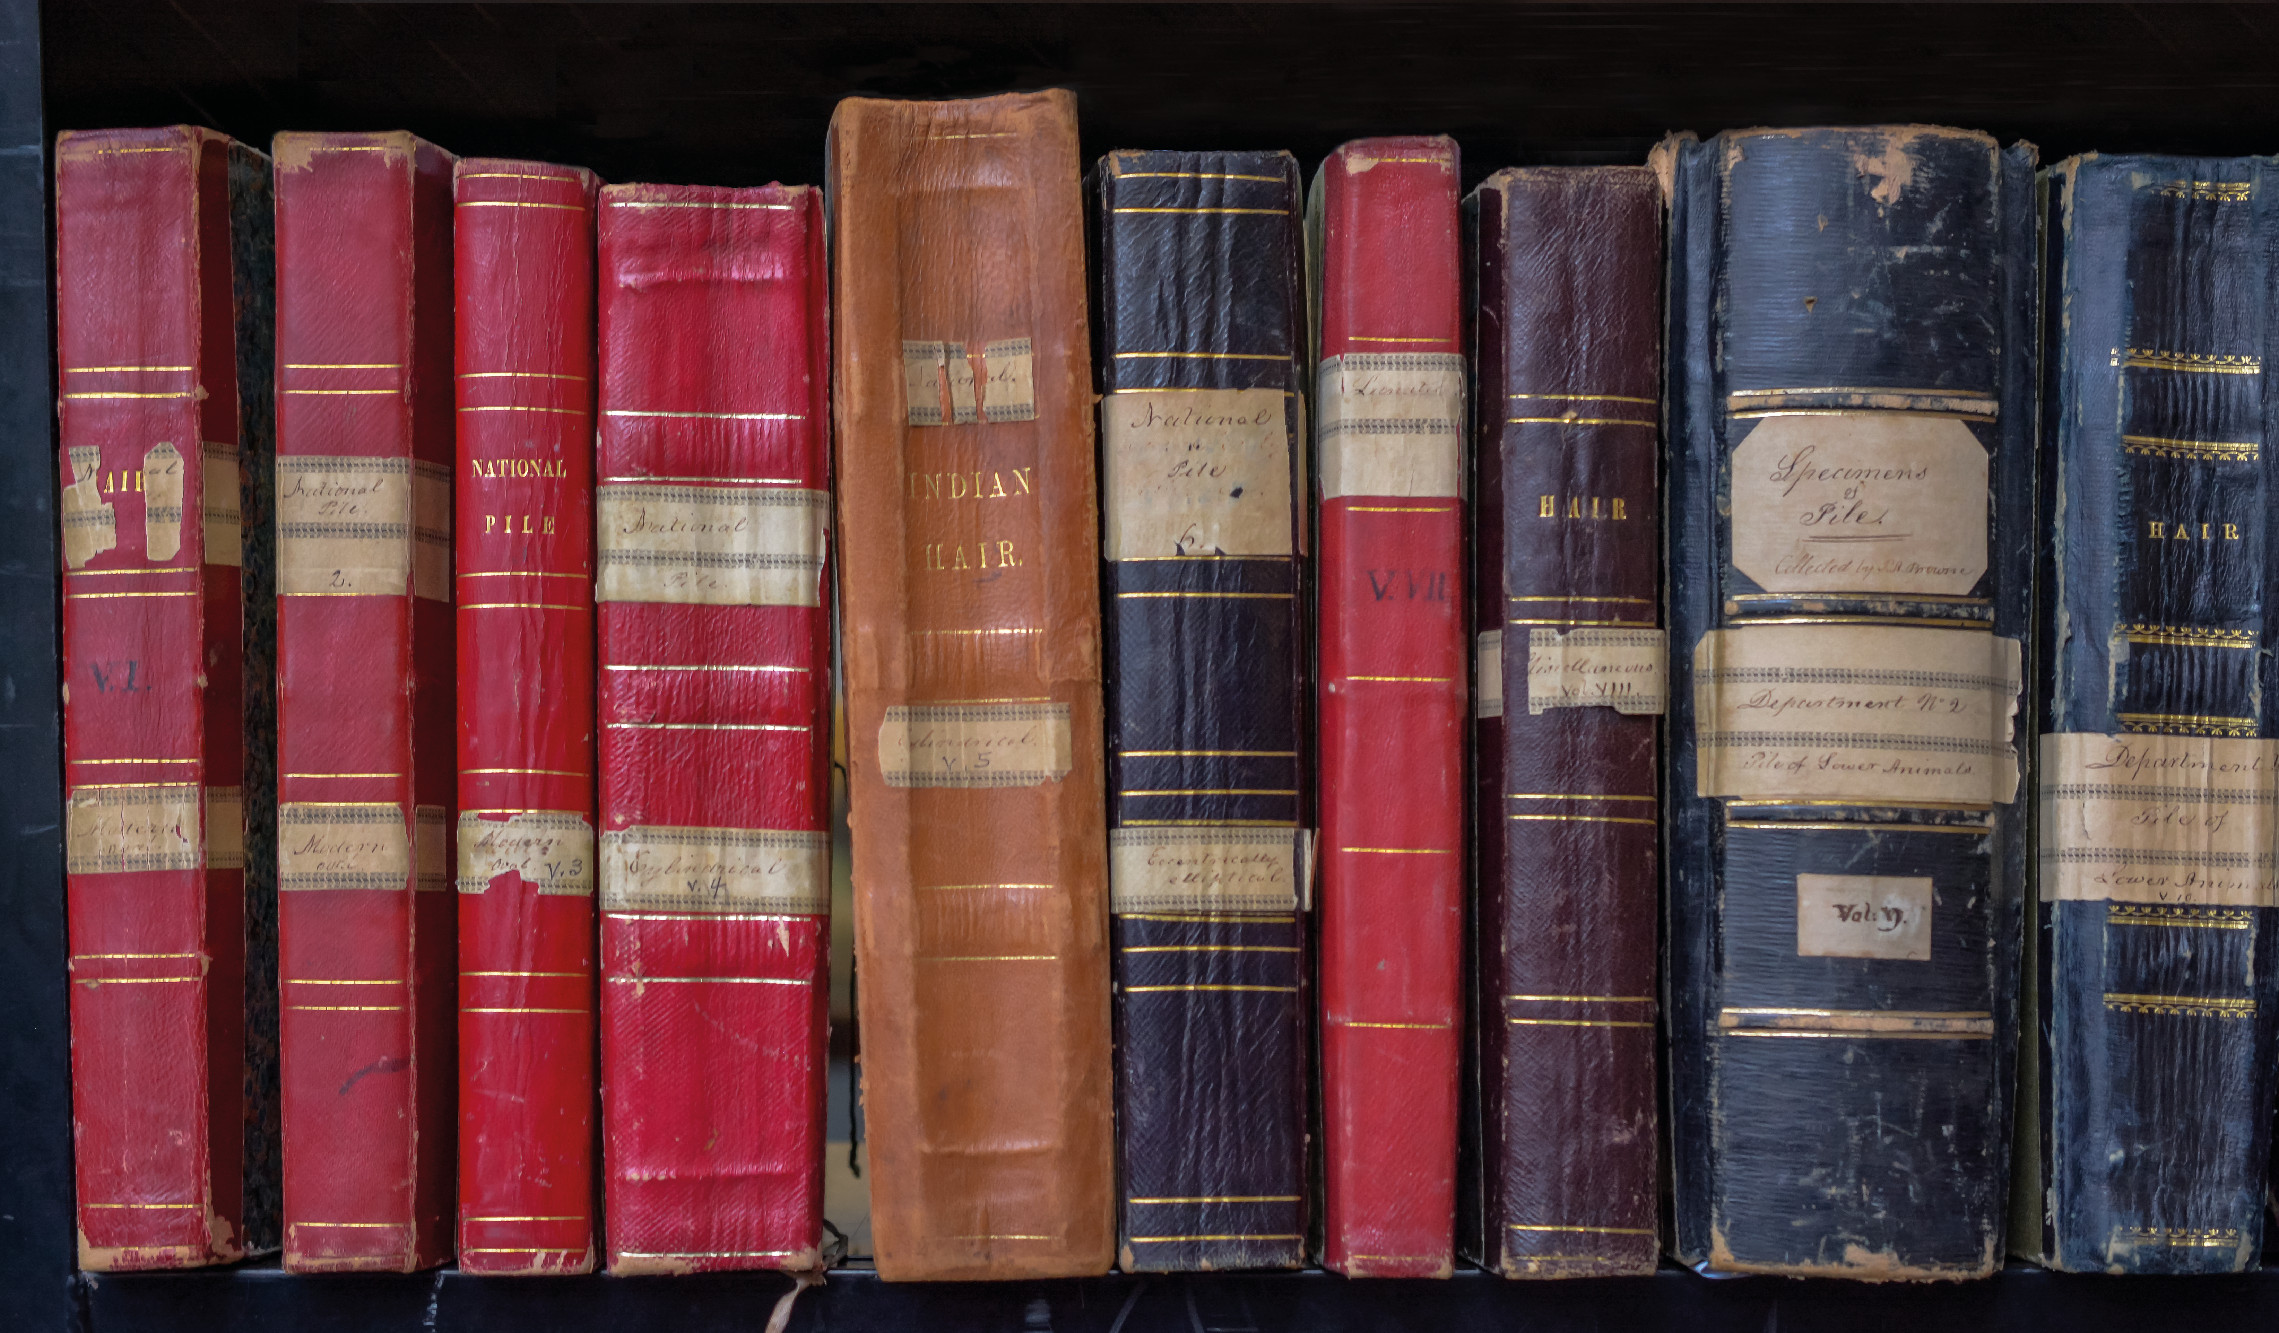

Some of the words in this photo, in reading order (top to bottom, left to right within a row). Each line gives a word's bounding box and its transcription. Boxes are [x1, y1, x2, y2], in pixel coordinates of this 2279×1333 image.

[1131, 402, 1272, 429] National
[471, 458, 567, 478] NATIONAL
[1769, 445, 1928, 497] Specimens
[283, 475, 384, 498] National
[909, 467, 1031, 499] INDIAN
[1844, 486, 1859, 500] of
[1540, 495, 1627, 520] HAIR
[485, 514, 555, 535] PILE
[623, 507, 749, 535] National
[2148, 521, 2240, 541] HAIR
[1775, 553, 1849, 576] Collected
[1737, 688, 1903, 717] Department
[1744, 751, 1784, 770] Pile
[1786, 756, 1809, 774] of
[1882, 758, 1973, 775] Animals
[2085, 745, 2260, 781] Department
[2131, 804, 2196, 825] Pile
[2204, 810, 2229, 833] of
